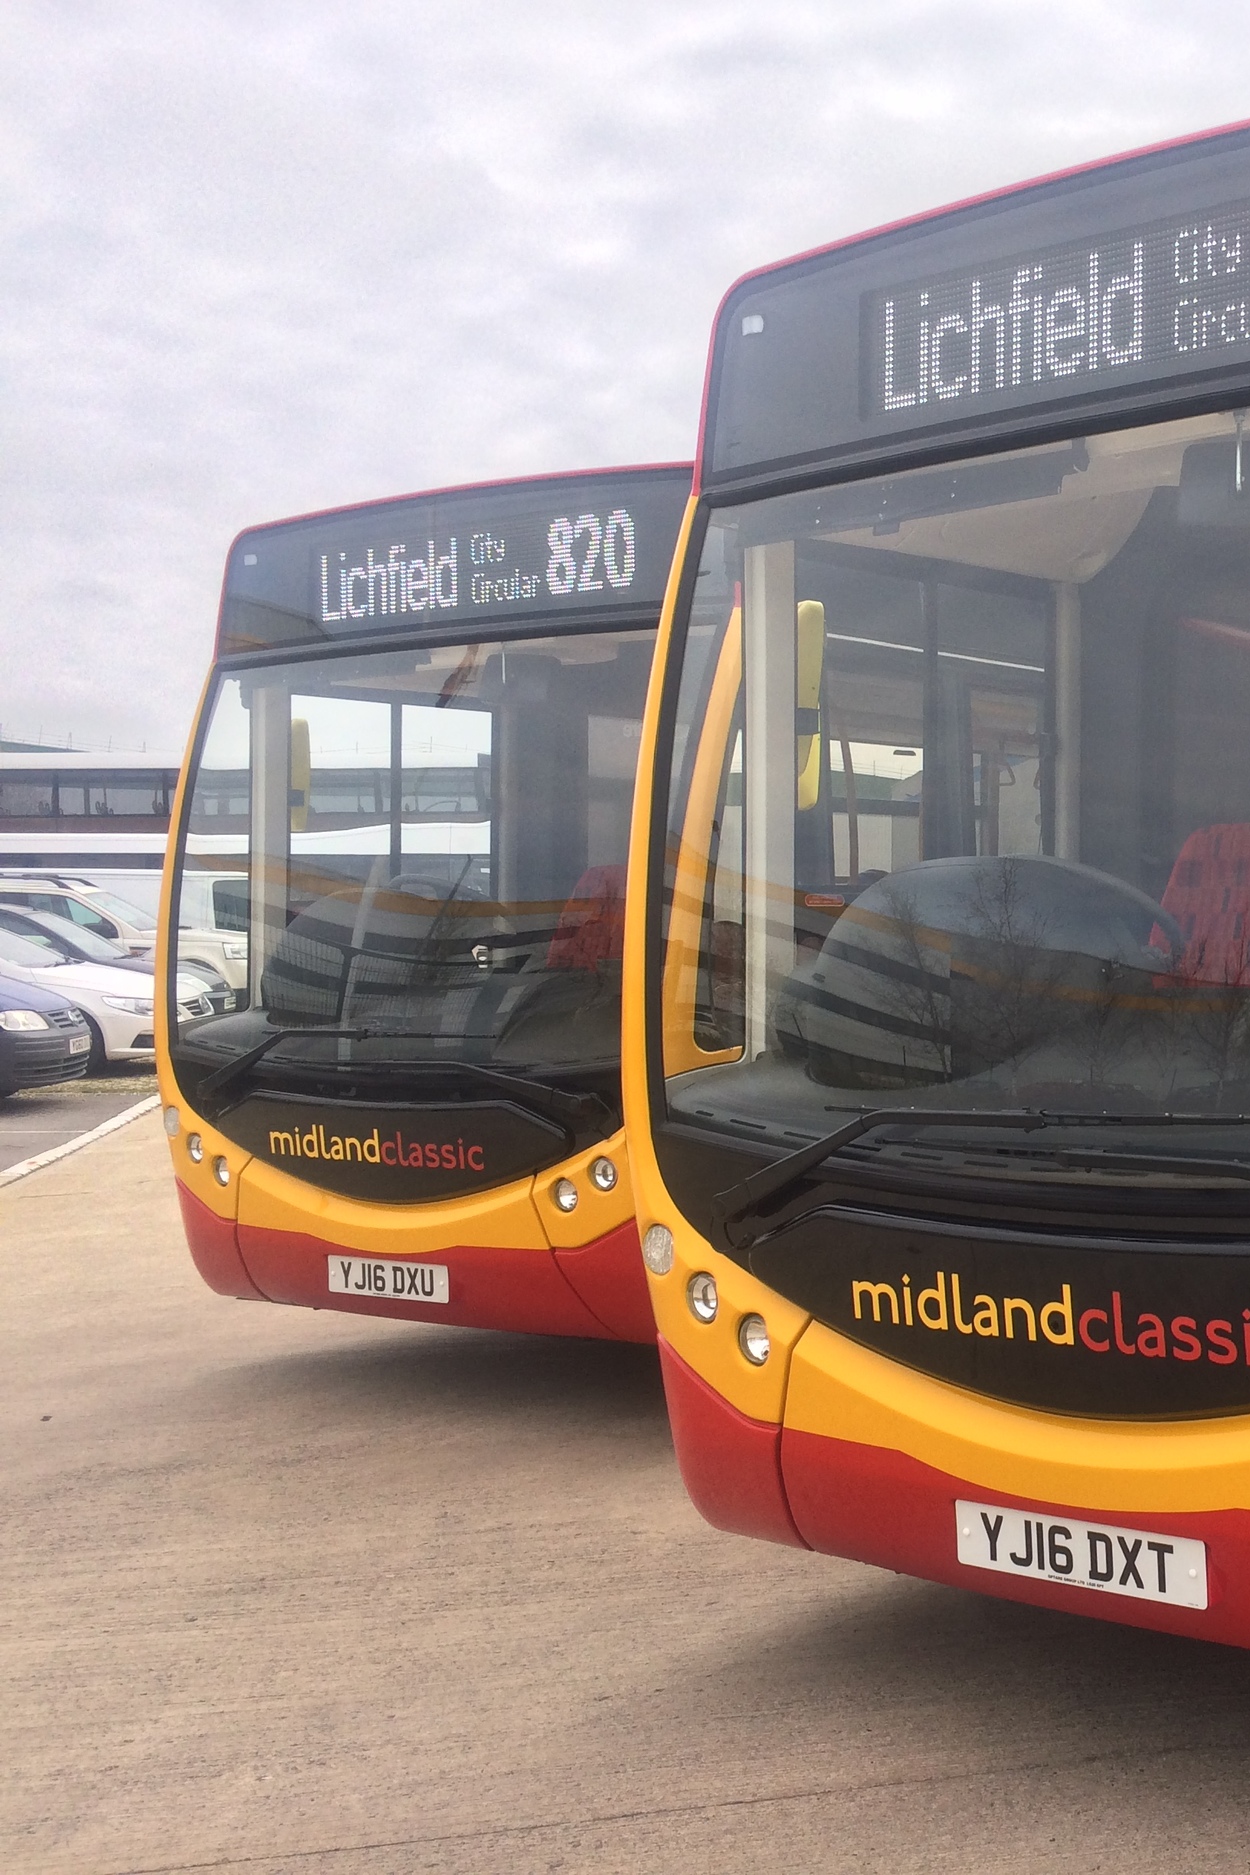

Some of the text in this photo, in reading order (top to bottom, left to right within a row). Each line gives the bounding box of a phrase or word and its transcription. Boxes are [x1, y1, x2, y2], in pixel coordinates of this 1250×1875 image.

[1174, 225, 1241, 284] City
[883, 241, 1143, 411] Lichfield
[320, 537, 459, 621] Lichfield
[470, 532, 505, 565] City
[546, 509, 636, 595] 820
[470, 569, 541, 604] Circular
[340, 1260, 434, 1297] YJ16 DXU
[980, 1511, 1174, 1594] YJ16 DXT
